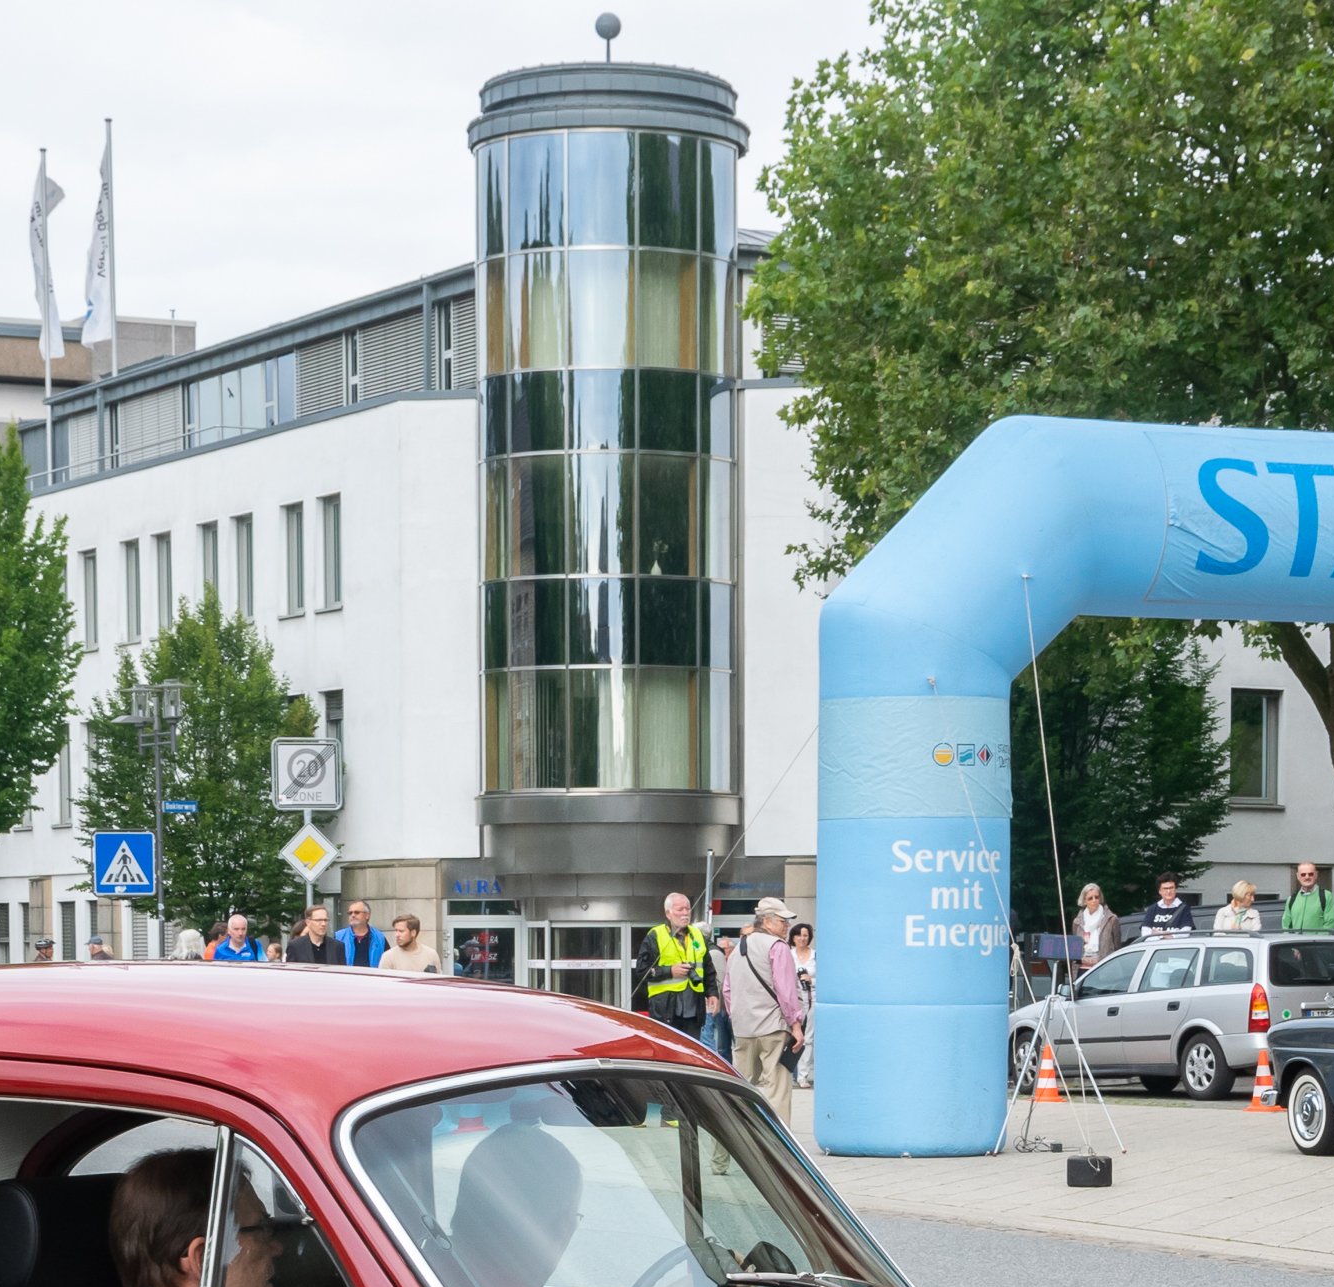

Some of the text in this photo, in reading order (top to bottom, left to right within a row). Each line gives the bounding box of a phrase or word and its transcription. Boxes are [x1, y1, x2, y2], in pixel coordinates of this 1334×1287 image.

[296, 759, 319, 779] 20
[292, 791, 323, 802] ZONE
[891, 840, 1001, 873] Service
[931, 878, 984, 910] mit
[905, 914, 1008, 956] Energie
